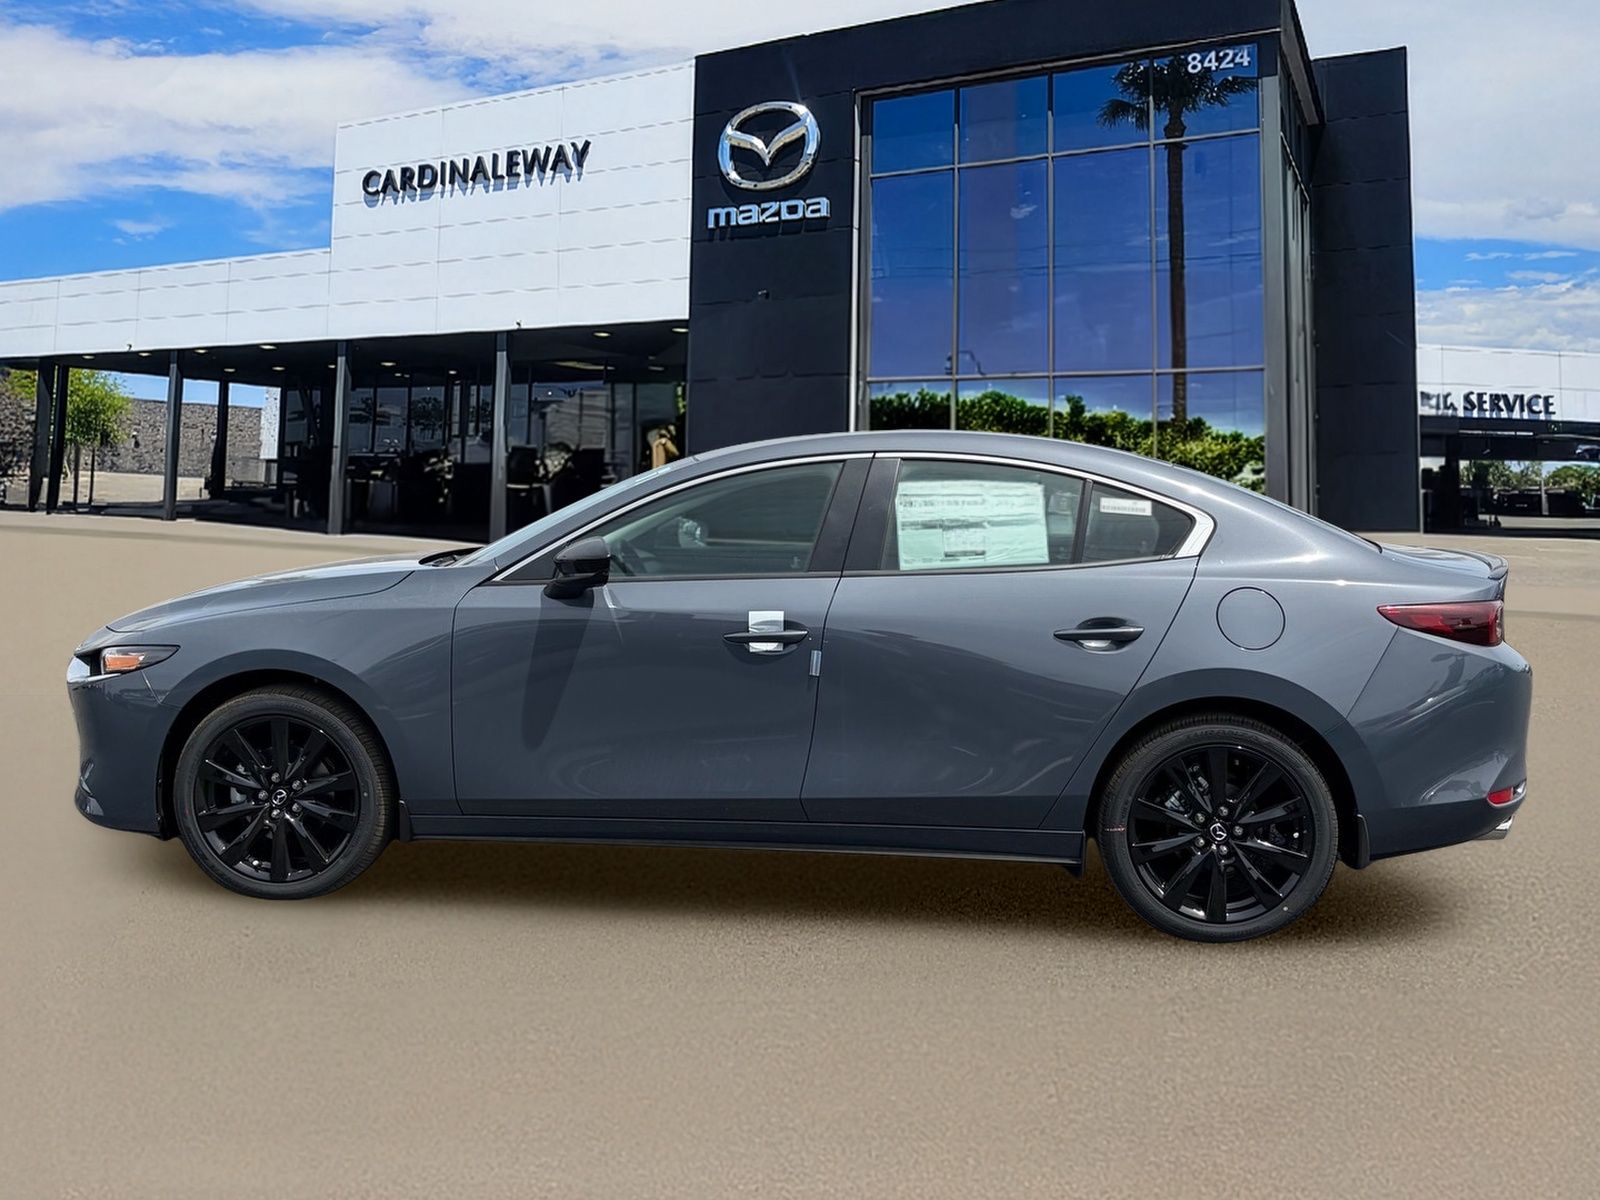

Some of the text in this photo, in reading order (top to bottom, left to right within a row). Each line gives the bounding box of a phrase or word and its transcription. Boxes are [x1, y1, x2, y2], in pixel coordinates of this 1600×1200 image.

[1187, 47, 1251, 73] 8424
[362, 139, 591, 196] CARDINALEWAY
[1463, 391, 1556, 415] SERVICE
